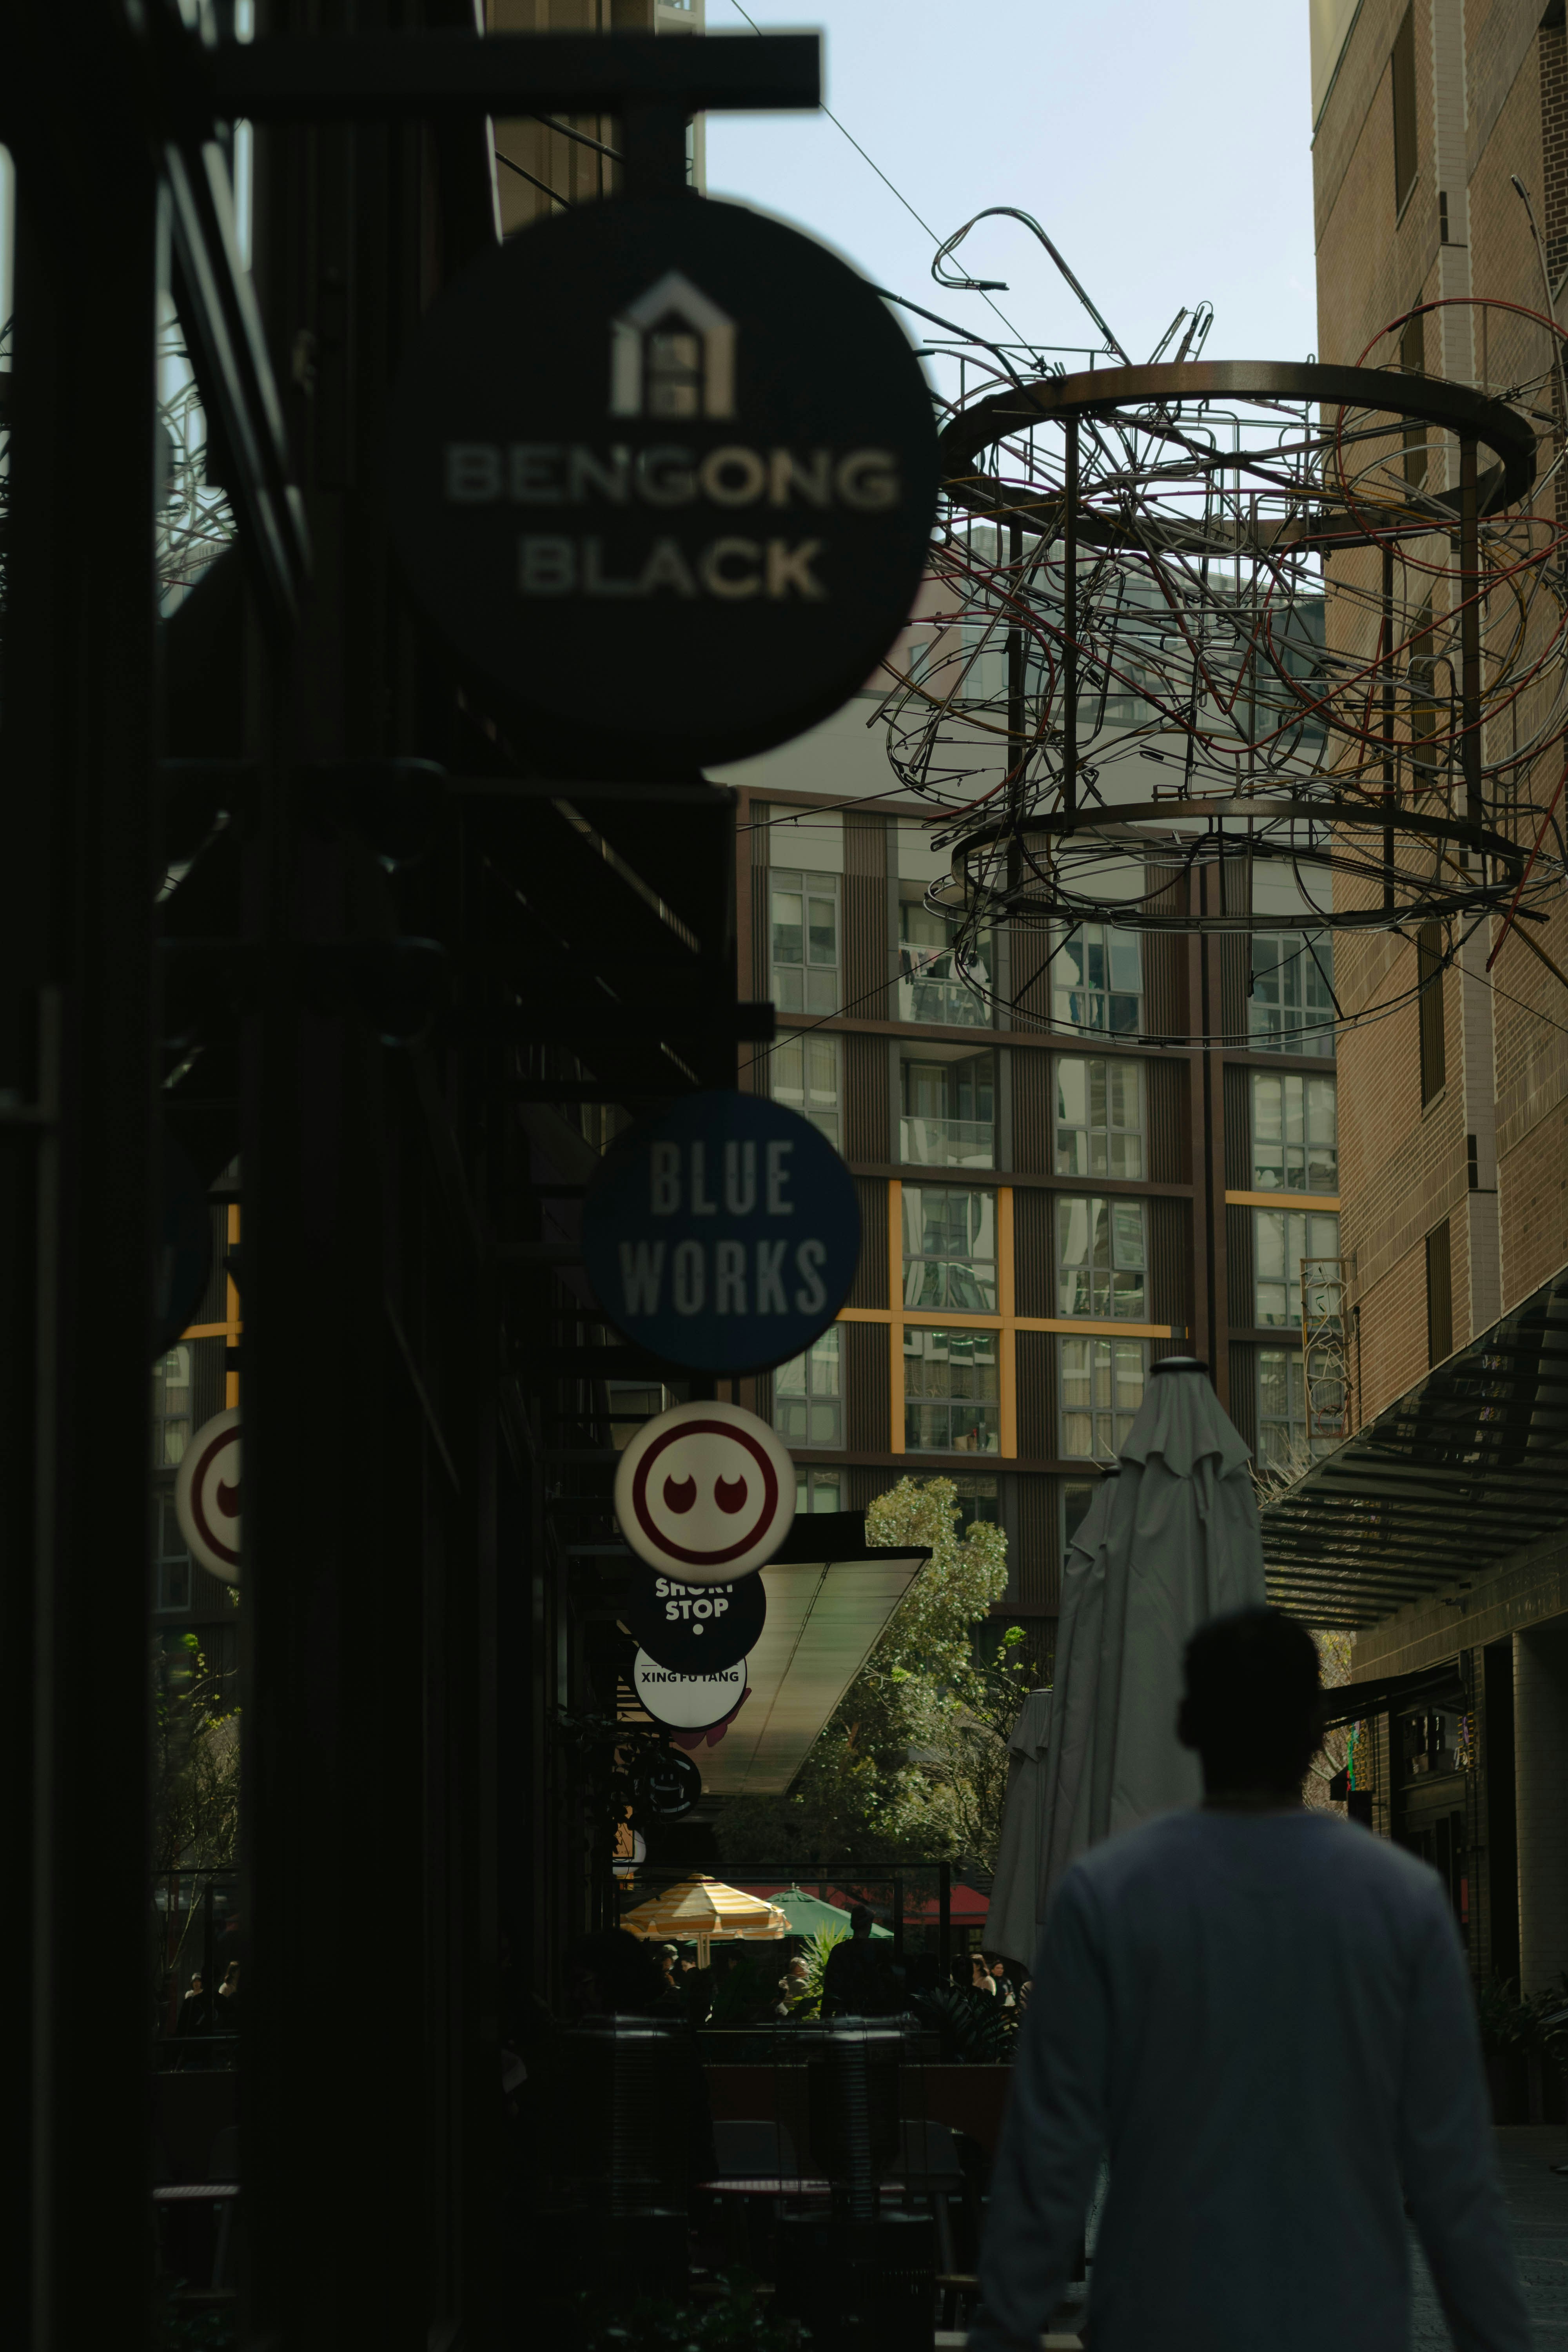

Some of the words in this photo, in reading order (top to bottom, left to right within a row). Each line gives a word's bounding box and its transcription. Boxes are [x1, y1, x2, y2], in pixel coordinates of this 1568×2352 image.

[444, 441, 900, 511] BENGONG
[517, 535, 827, 601] BLACK
[650, 1140, 794, 1216] BLUE
[619, 1239, 827, 1316] WORKS
[666, 1598, 729, 1621] STOP
[641, 1672, 677, 1682] XING
